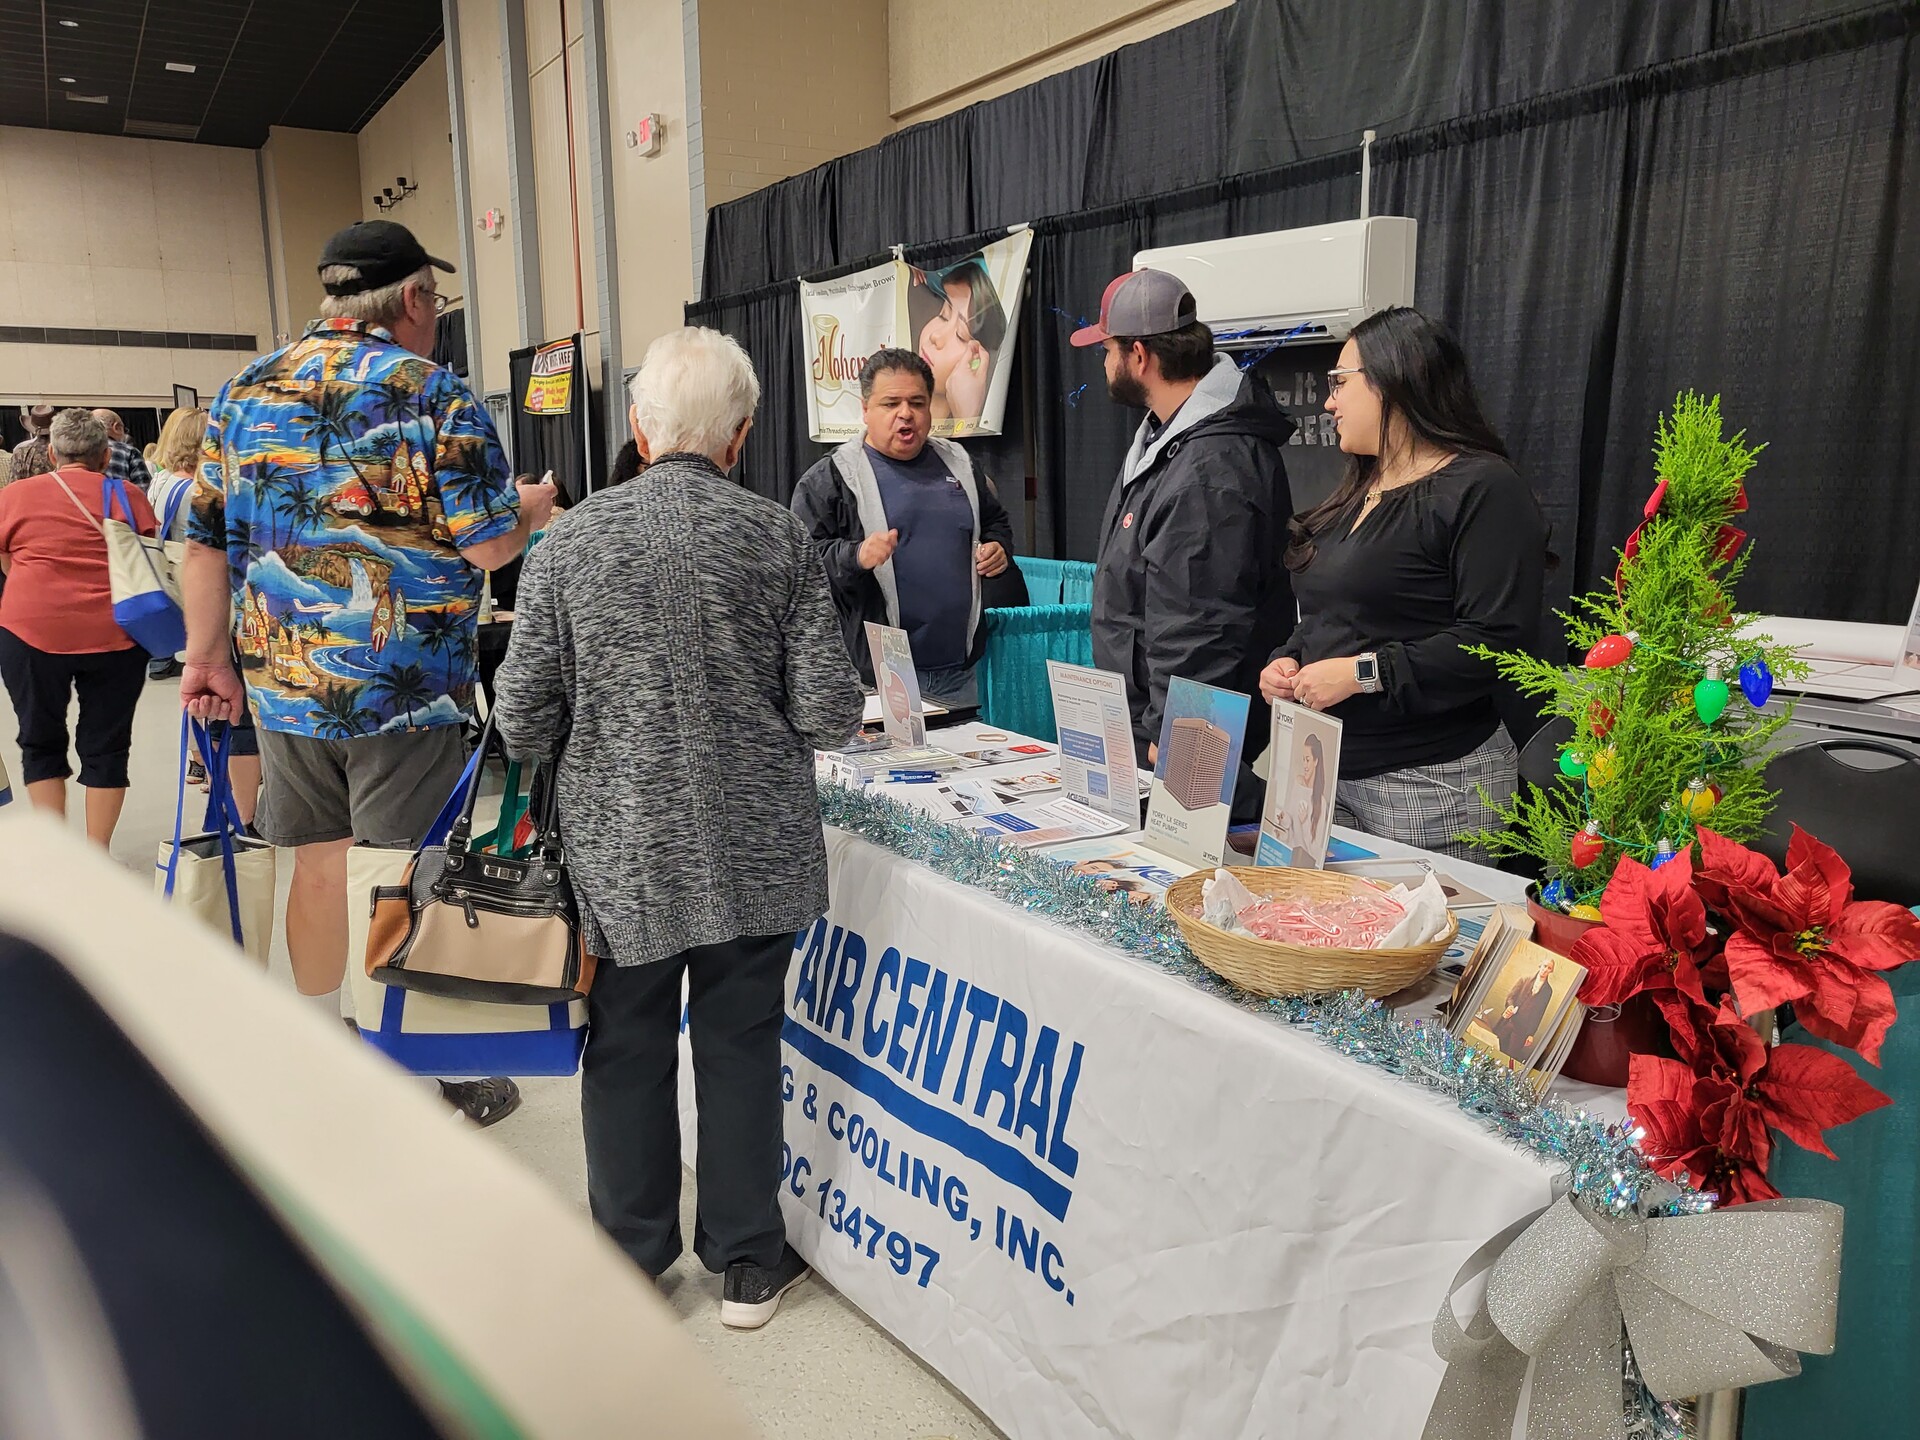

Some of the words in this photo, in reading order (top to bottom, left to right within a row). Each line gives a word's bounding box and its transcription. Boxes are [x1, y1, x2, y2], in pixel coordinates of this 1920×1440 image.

[872, 275, 896, 288] Brows
[1060, 672, 1092, 685] MAINTENANCE
[1093, 678, 1113, 689] OPTIONS
[1281, 713, 1294, 725] YORK
[1150, 818, 1162, 827] HEAT
[1162, 822, 1178, 834] PUMPS
[1173, 817, 1188, 830] SERIES
[1206, 852, 1219, 864] YORK
[793, 918, 868, 1041] AIR
[862, 946, 1085, 1179] CENTRAL
[802, 1083, 818, 1123] &
[828, 1101, 983, 1242] COOLING,
[995, 1205, 1075, 1307] INC.
[816, 1178, 941, 1289] 134797
